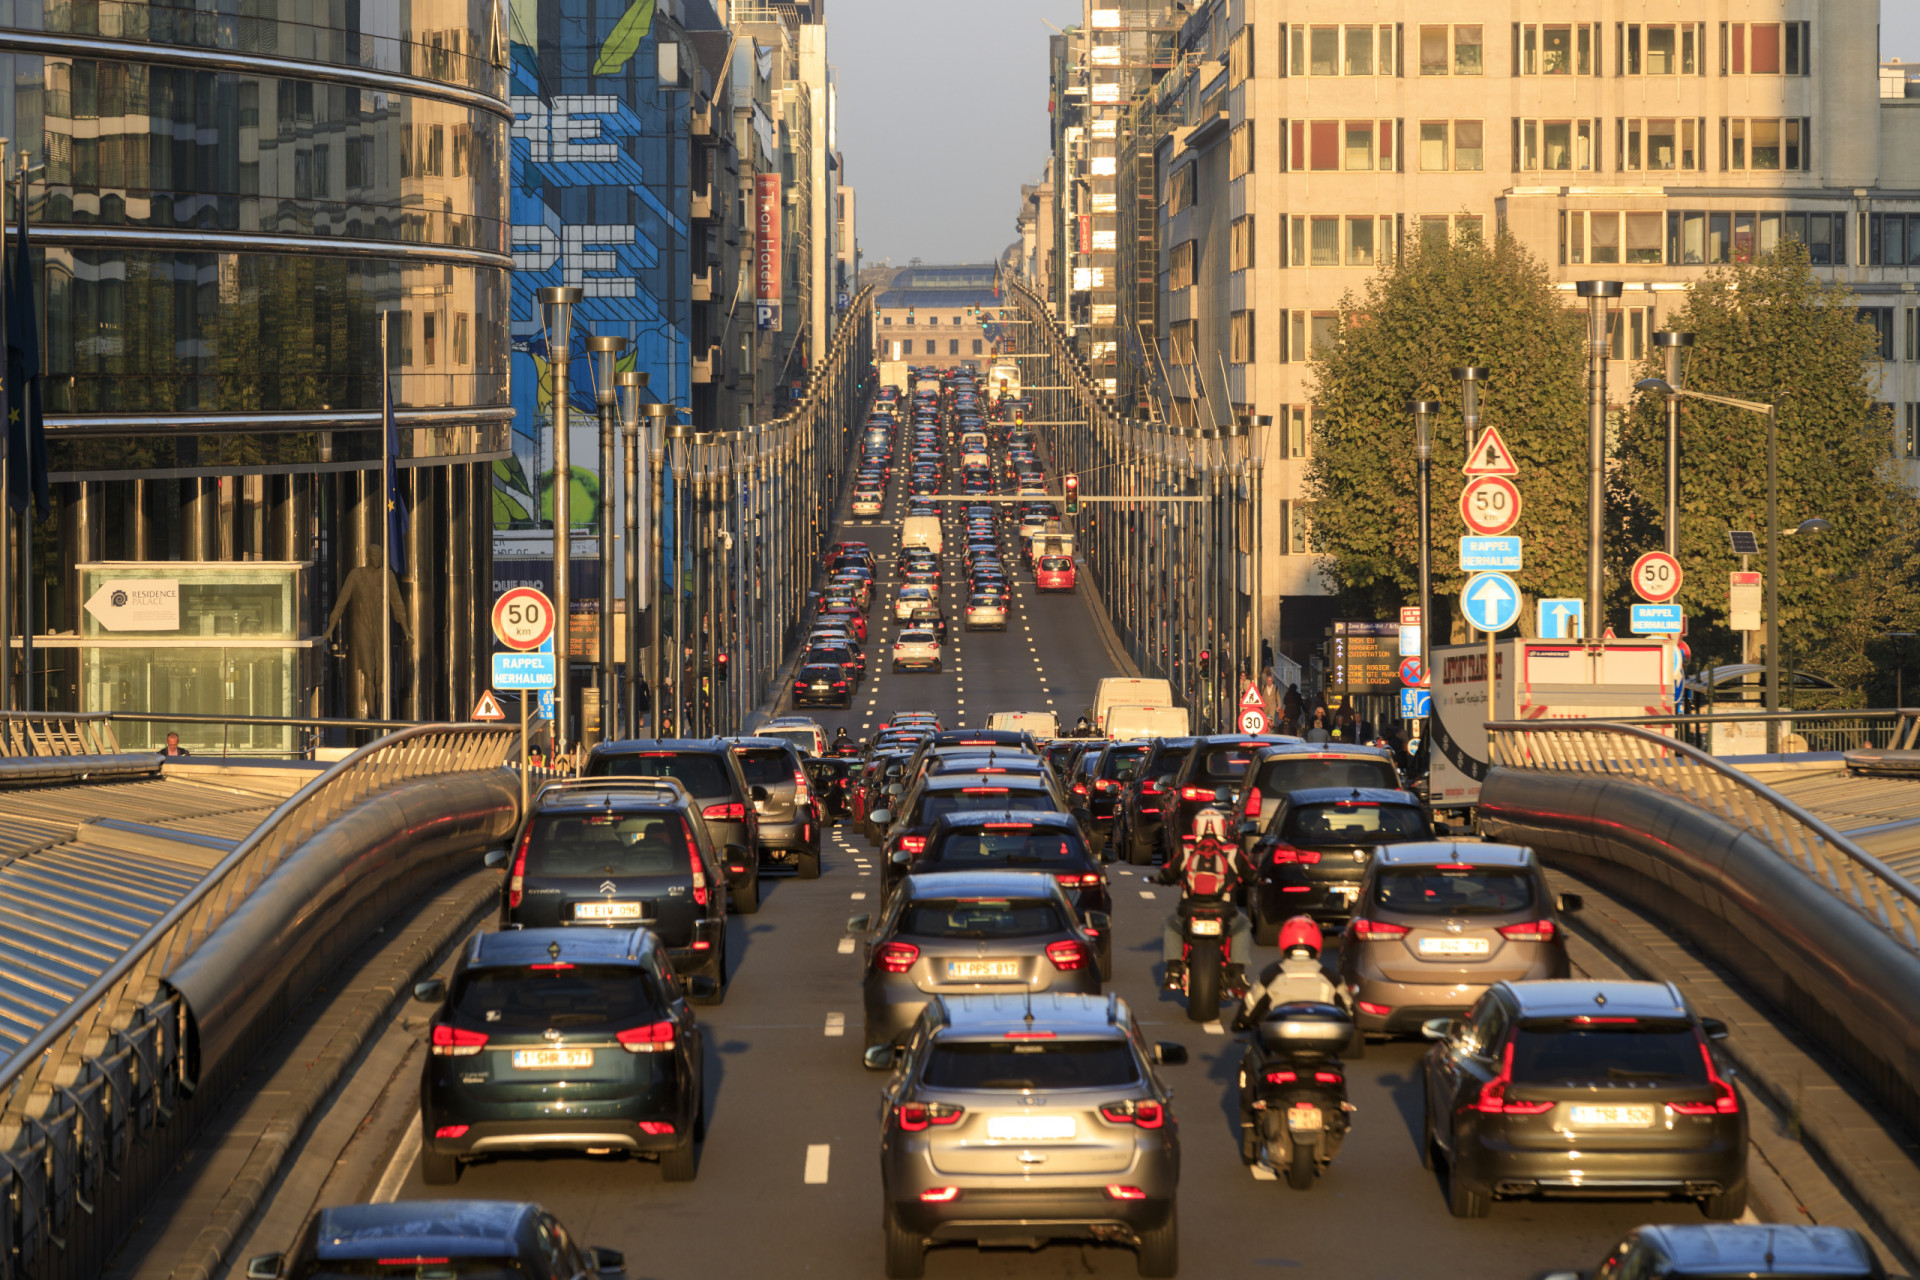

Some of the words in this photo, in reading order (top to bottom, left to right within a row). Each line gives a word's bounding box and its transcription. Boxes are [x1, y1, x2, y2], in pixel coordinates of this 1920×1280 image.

[761, 191, 774, 233] Thon
[761, 239, 775, 292] Hotels
[839, 293, 848, 305] P
[758, 306, 772, 325] P
[1476, 491, 1505, 511] 50
[1484, 513, 1499, 521] km
[1470, 541, 1511, 551] RAPPEL
[1463, 556, 1519, 566] HERHALING
[1645, 565, 1669, 581] 50
[132, 590, 176, 598] RESIDENCE
[132, 598, 164, 606] PALACE
[508, 604, 539, 624] 50
[1639, 608, 1674, 617] RAPPEL
[1336, 623, 1344, 633] P
[1633, 621, 1681, 630] HERHALING
[516, 627, 531, 636] km
[502, 658, 545, 668] RAPPEL
[495, 674, 553, 684] HERHALING
[1245, 716, 1261, 729] 30
